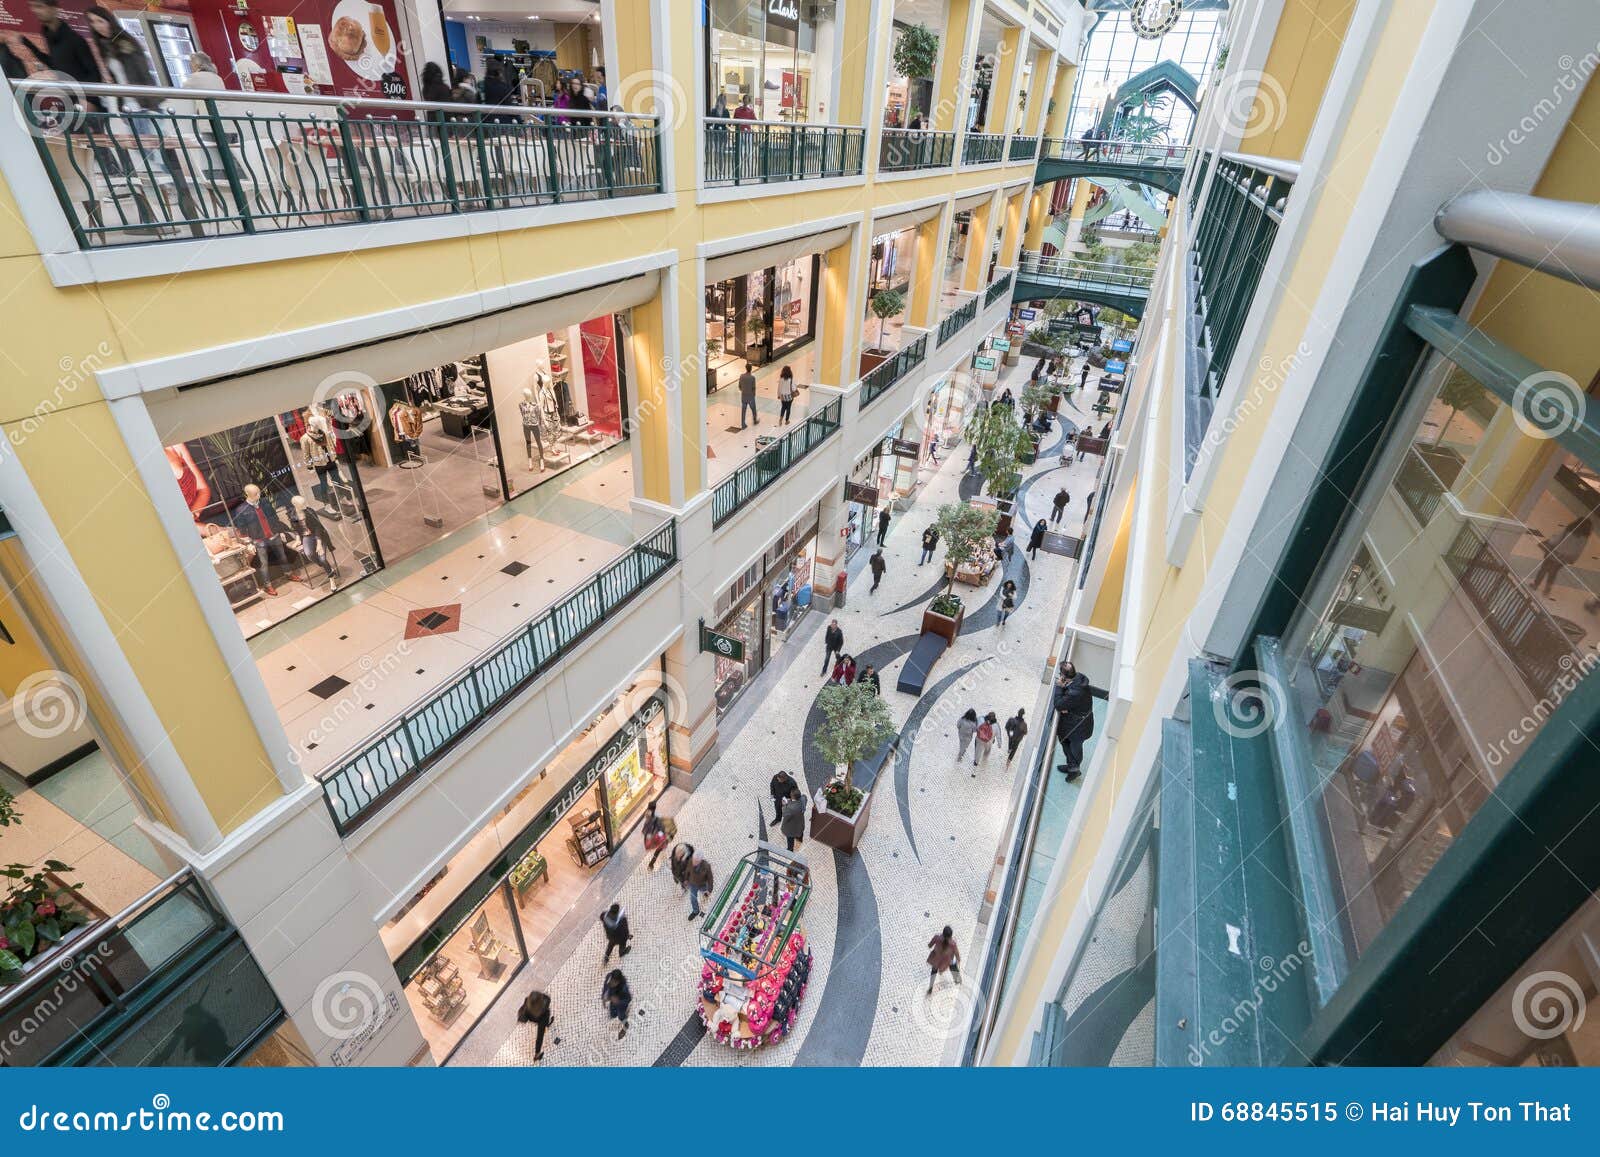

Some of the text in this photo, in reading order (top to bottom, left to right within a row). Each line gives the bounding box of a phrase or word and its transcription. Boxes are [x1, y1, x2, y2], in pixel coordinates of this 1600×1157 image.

[769, 0, 798, 20] Clarks
[551, 700, 661, 818] THE BODY SHOP
